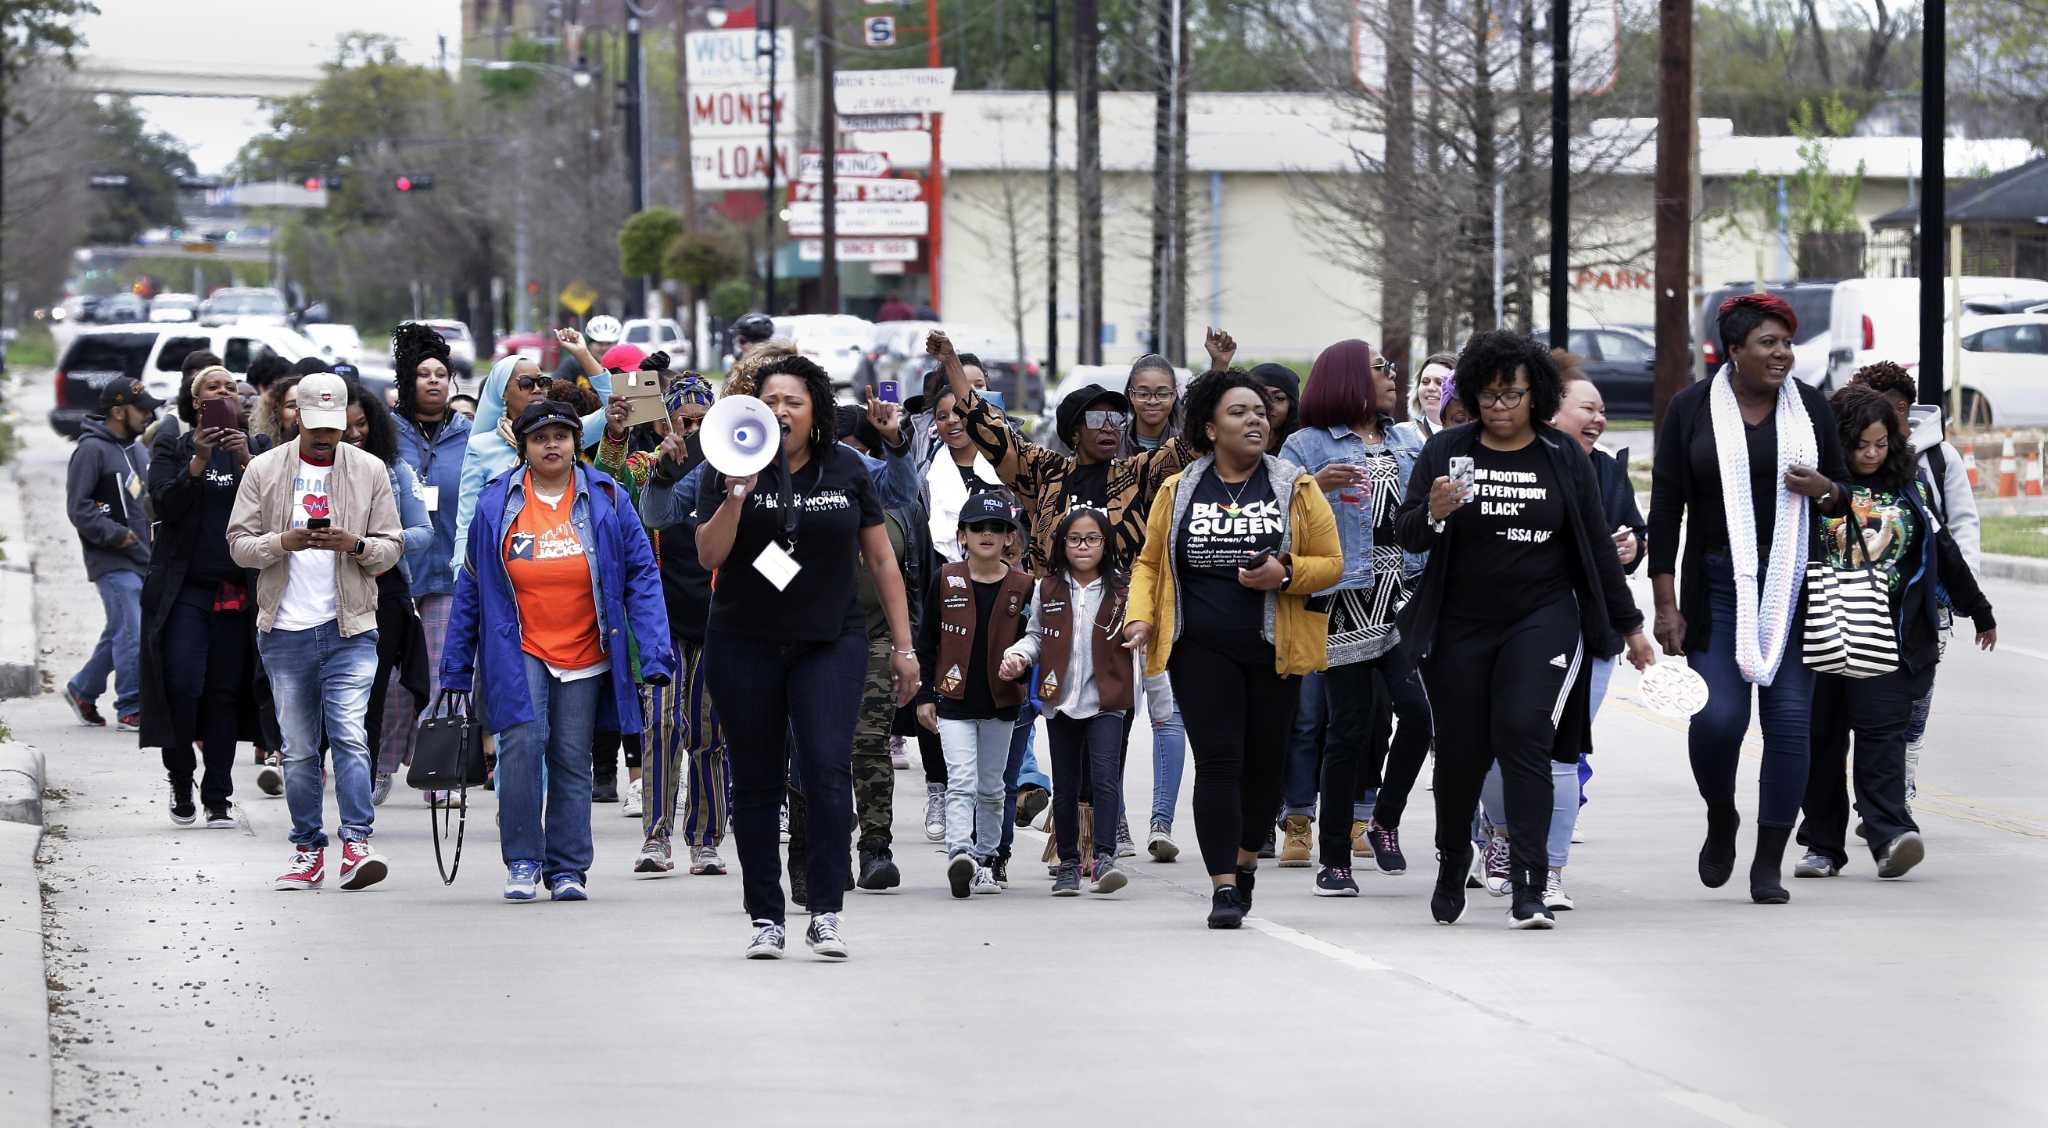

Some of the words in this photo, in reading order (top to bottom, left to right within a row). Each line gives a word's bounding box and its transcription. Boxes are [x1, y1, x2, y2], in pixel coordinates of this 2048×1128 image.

[872, 20, 889, 41] S
[694, 92, 786, 126] MONEY
[718, 145, 791, 179] LOAN
[800, 154, 879, 172] PAKING
[1576, 270, 1654, 290] PARK
[295, 477, 333, 494] BLAC
[1489, 470, 1537, 483] ROOTING
[1481, 484, 1546, 500] EVERYBODY
[805, 496, 848, 507] WOMEN
[1188, 517, 1284, 535] QUEEN
[536, 543, 584, 559] JACKS
